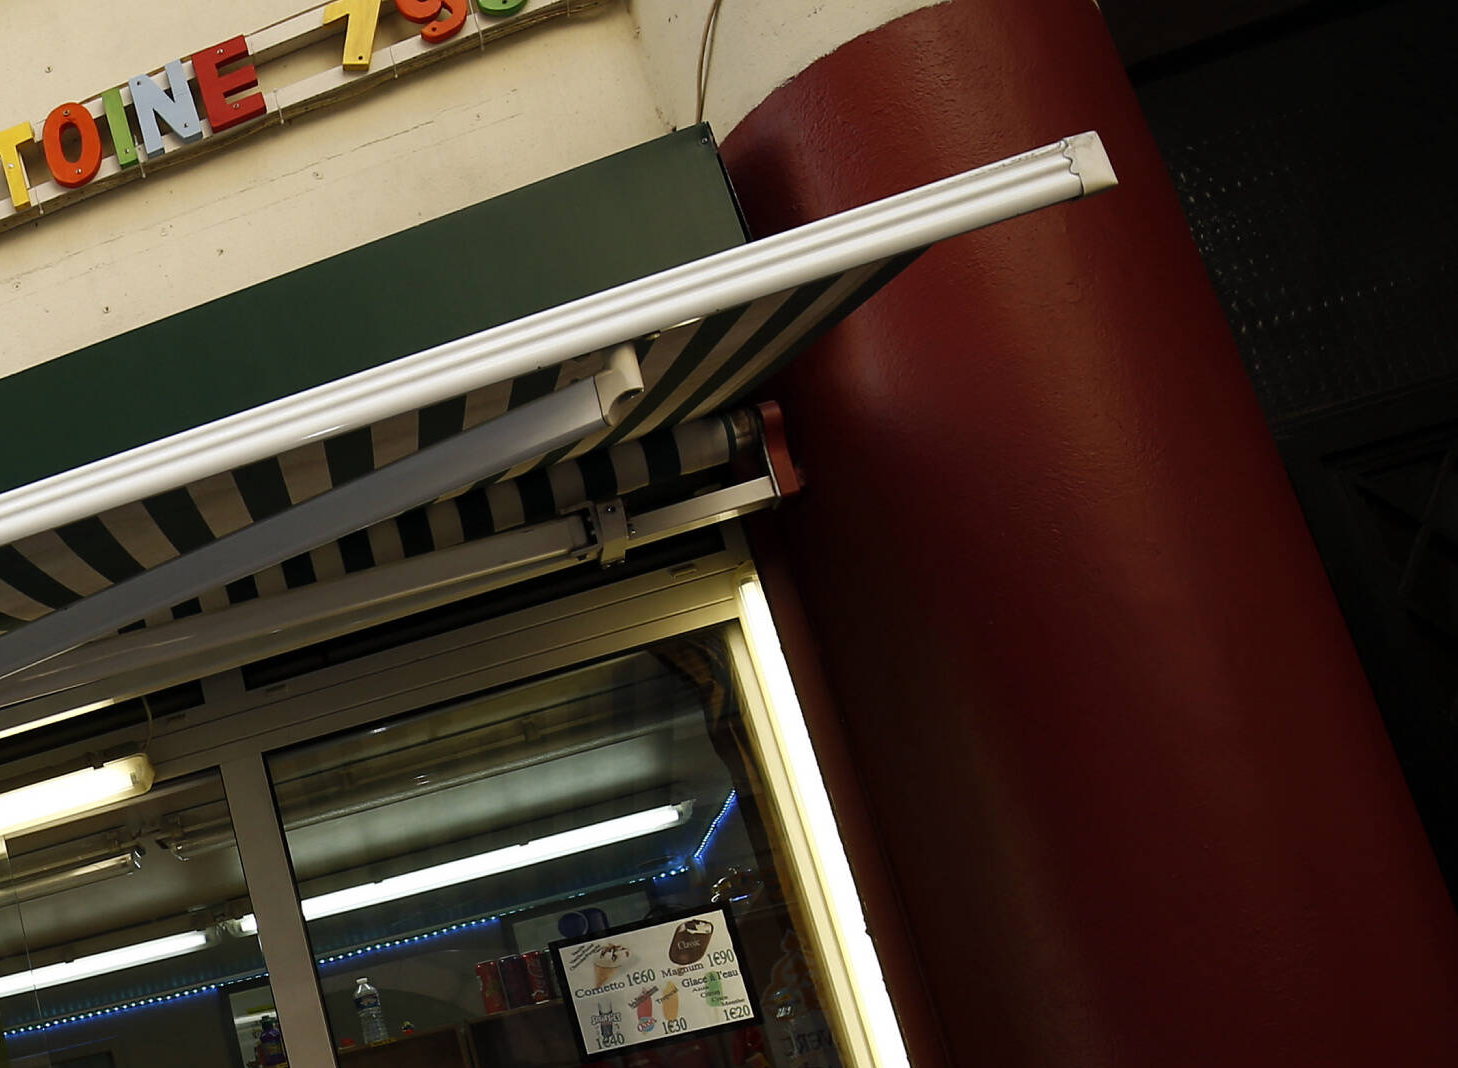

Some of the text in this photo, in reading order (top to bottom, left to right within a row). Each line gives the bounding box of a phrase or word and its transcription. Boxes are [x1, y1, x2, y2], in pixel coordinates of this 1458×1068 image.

[321, 0, 529, 71] 79
[661, 948, 735, 979] Magnum 1€90
[626, 968, 655, 987] 1€60
[682, 976, 708, 989] Glace
[718, 968, 739, 981] l'eau
[722, 1005, 751, 1021] 1€20
[662, 1018, 687, 1034] 1€30
